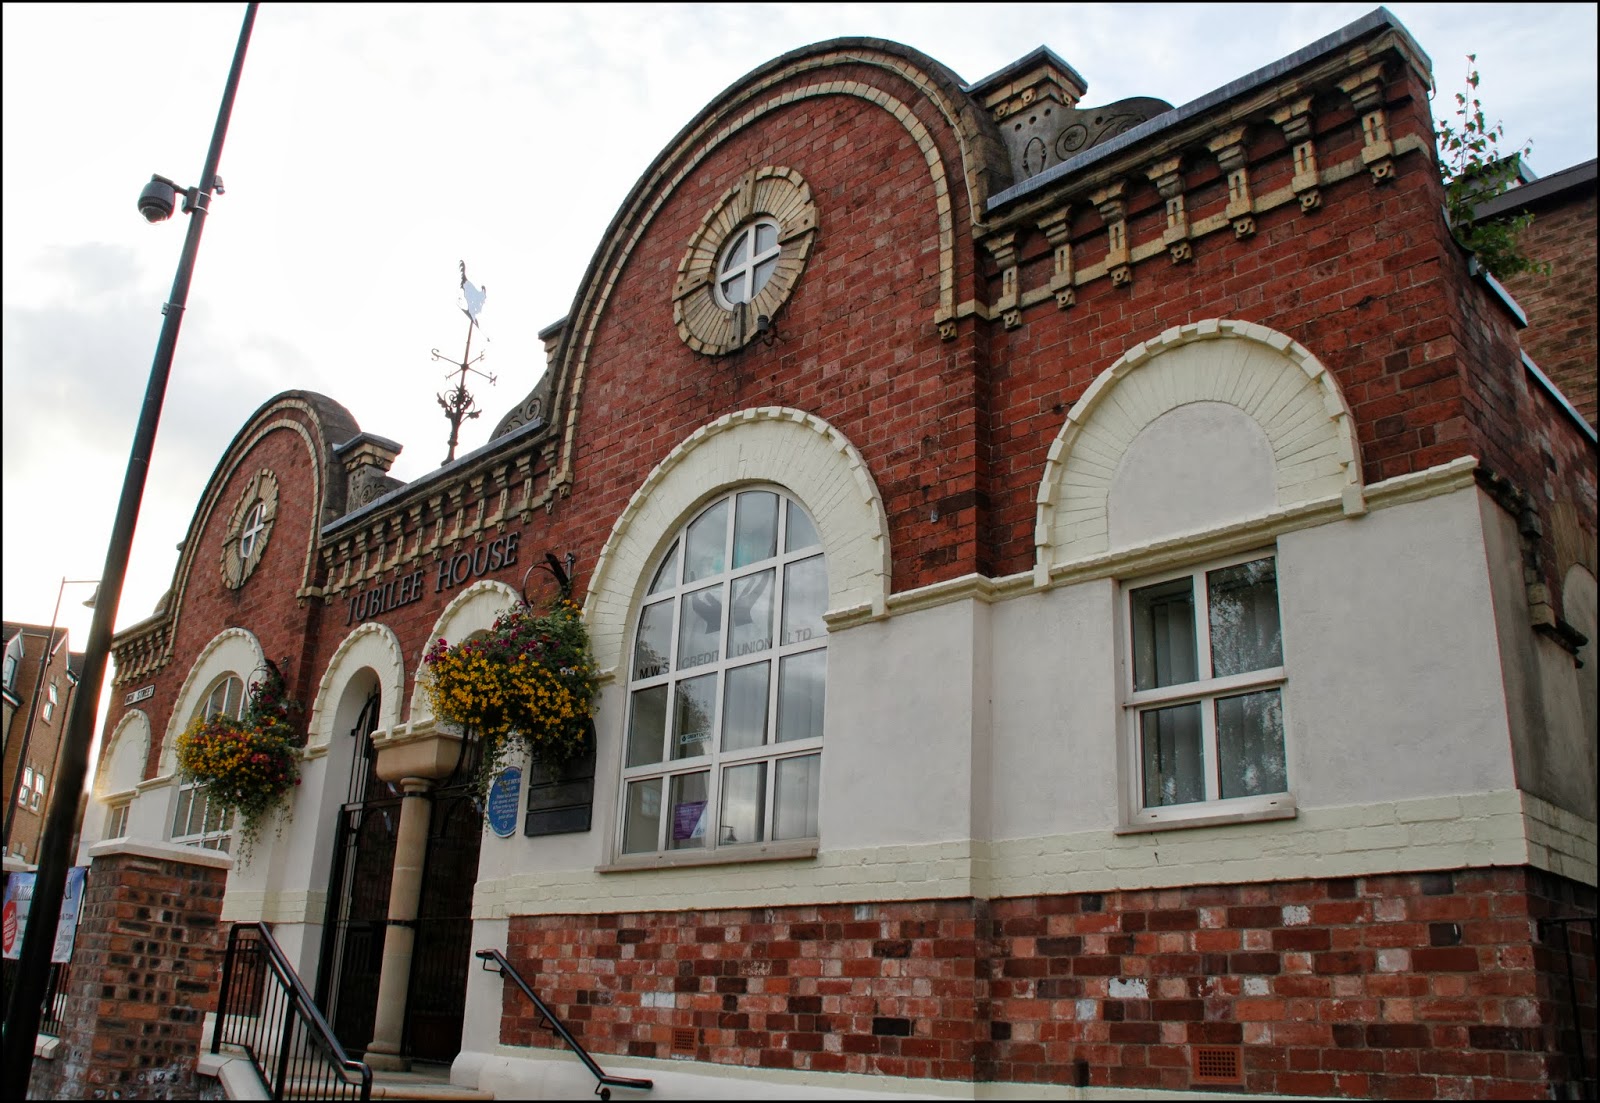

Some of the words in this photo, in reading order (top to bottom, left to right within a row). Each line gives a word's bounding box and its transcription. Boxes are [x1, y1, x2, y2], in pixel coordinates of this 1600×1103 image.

[346, 570, 424, 625] JUBILEE
[435, 532, 519, 592] HOUSE
[681, 650, 719, 669] CREDIT
[737, 637, 772, 656] UNION
[787, 628, 812, 644] LTD
